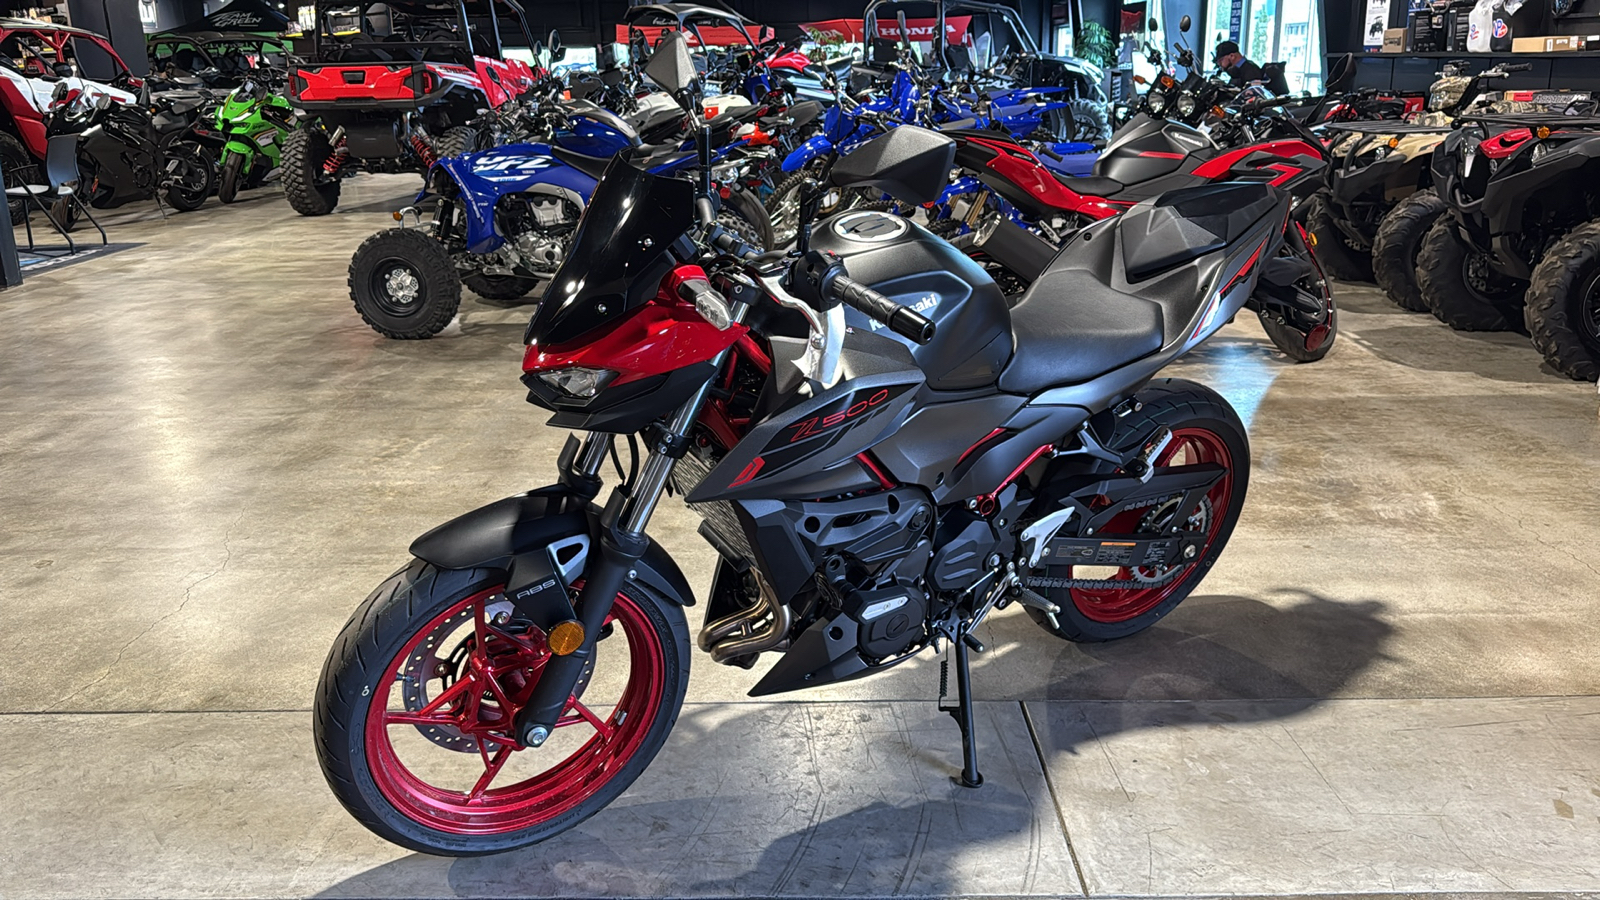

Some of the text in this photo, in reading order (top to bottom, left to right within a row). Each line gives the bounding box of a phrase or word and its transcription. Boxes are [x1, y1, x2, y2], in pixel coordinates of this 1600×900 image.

[213, 17, 262, 27] GREEN
[473, 155, 553, 173] YFZ
[516, 579, 556, 600] ABS
